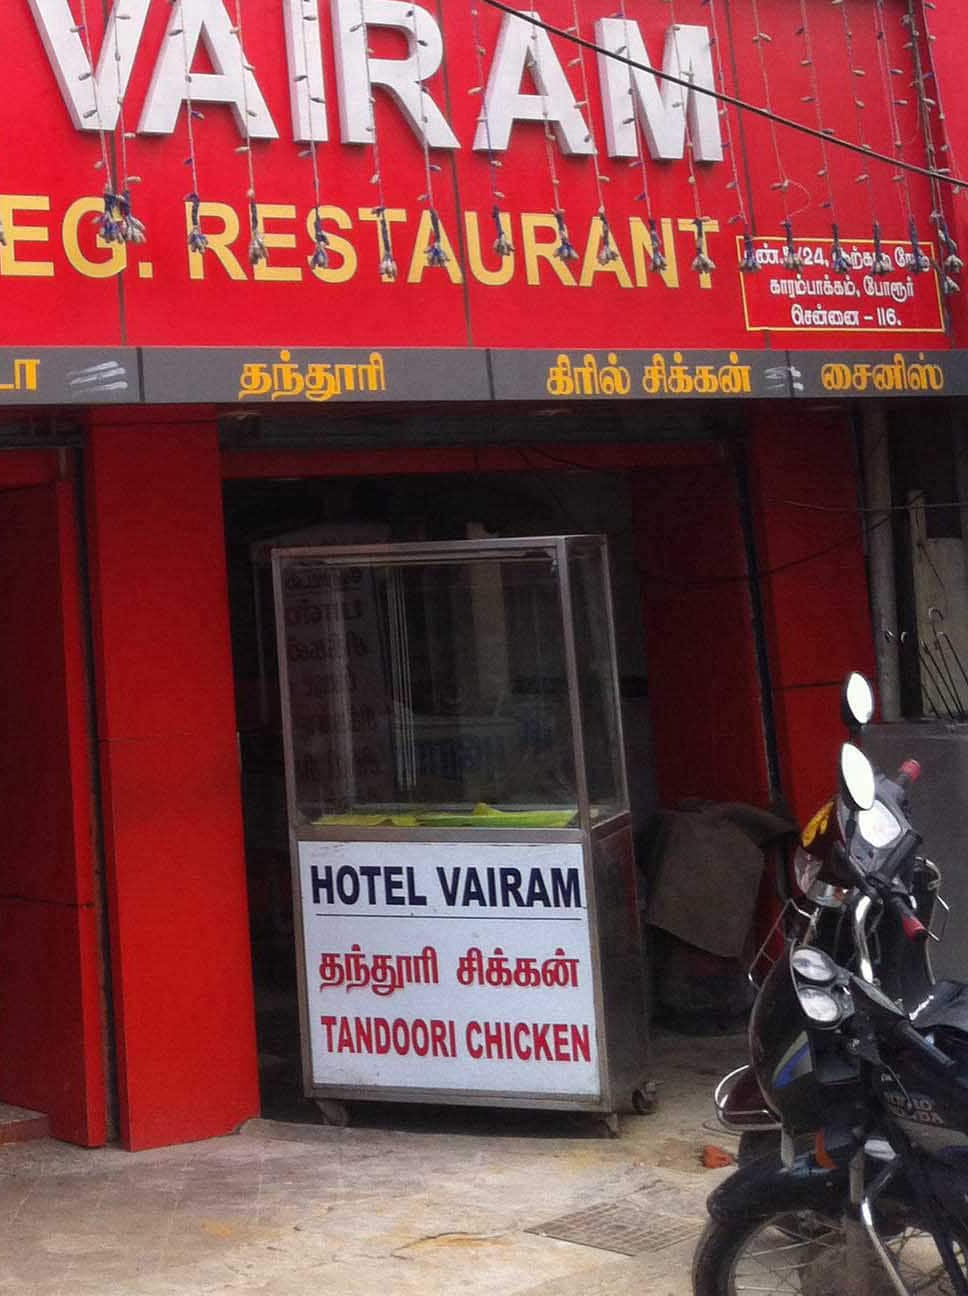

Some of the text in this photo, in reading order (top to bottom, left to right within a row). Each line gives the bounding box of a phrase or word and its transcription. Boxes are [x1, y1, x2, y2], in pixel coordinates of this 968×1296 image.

[184, 200, 720, 291] RESTAURANT
[769, 273, 914, 302] காரம்பாக்கம், போரூர்
[791, 303, 859, 326] சென்னை
[238, 349, 386, 402] தந்தூரி
[642, 351, 752, 394] சிக்கன்
[310, 865, 584, 908] HOTEL VAIRAM
[319, 943, 580, 996] தந்தூரி சிக்கன்
[320, 1015, 592, 1063] TANDOORI CHICKEN
